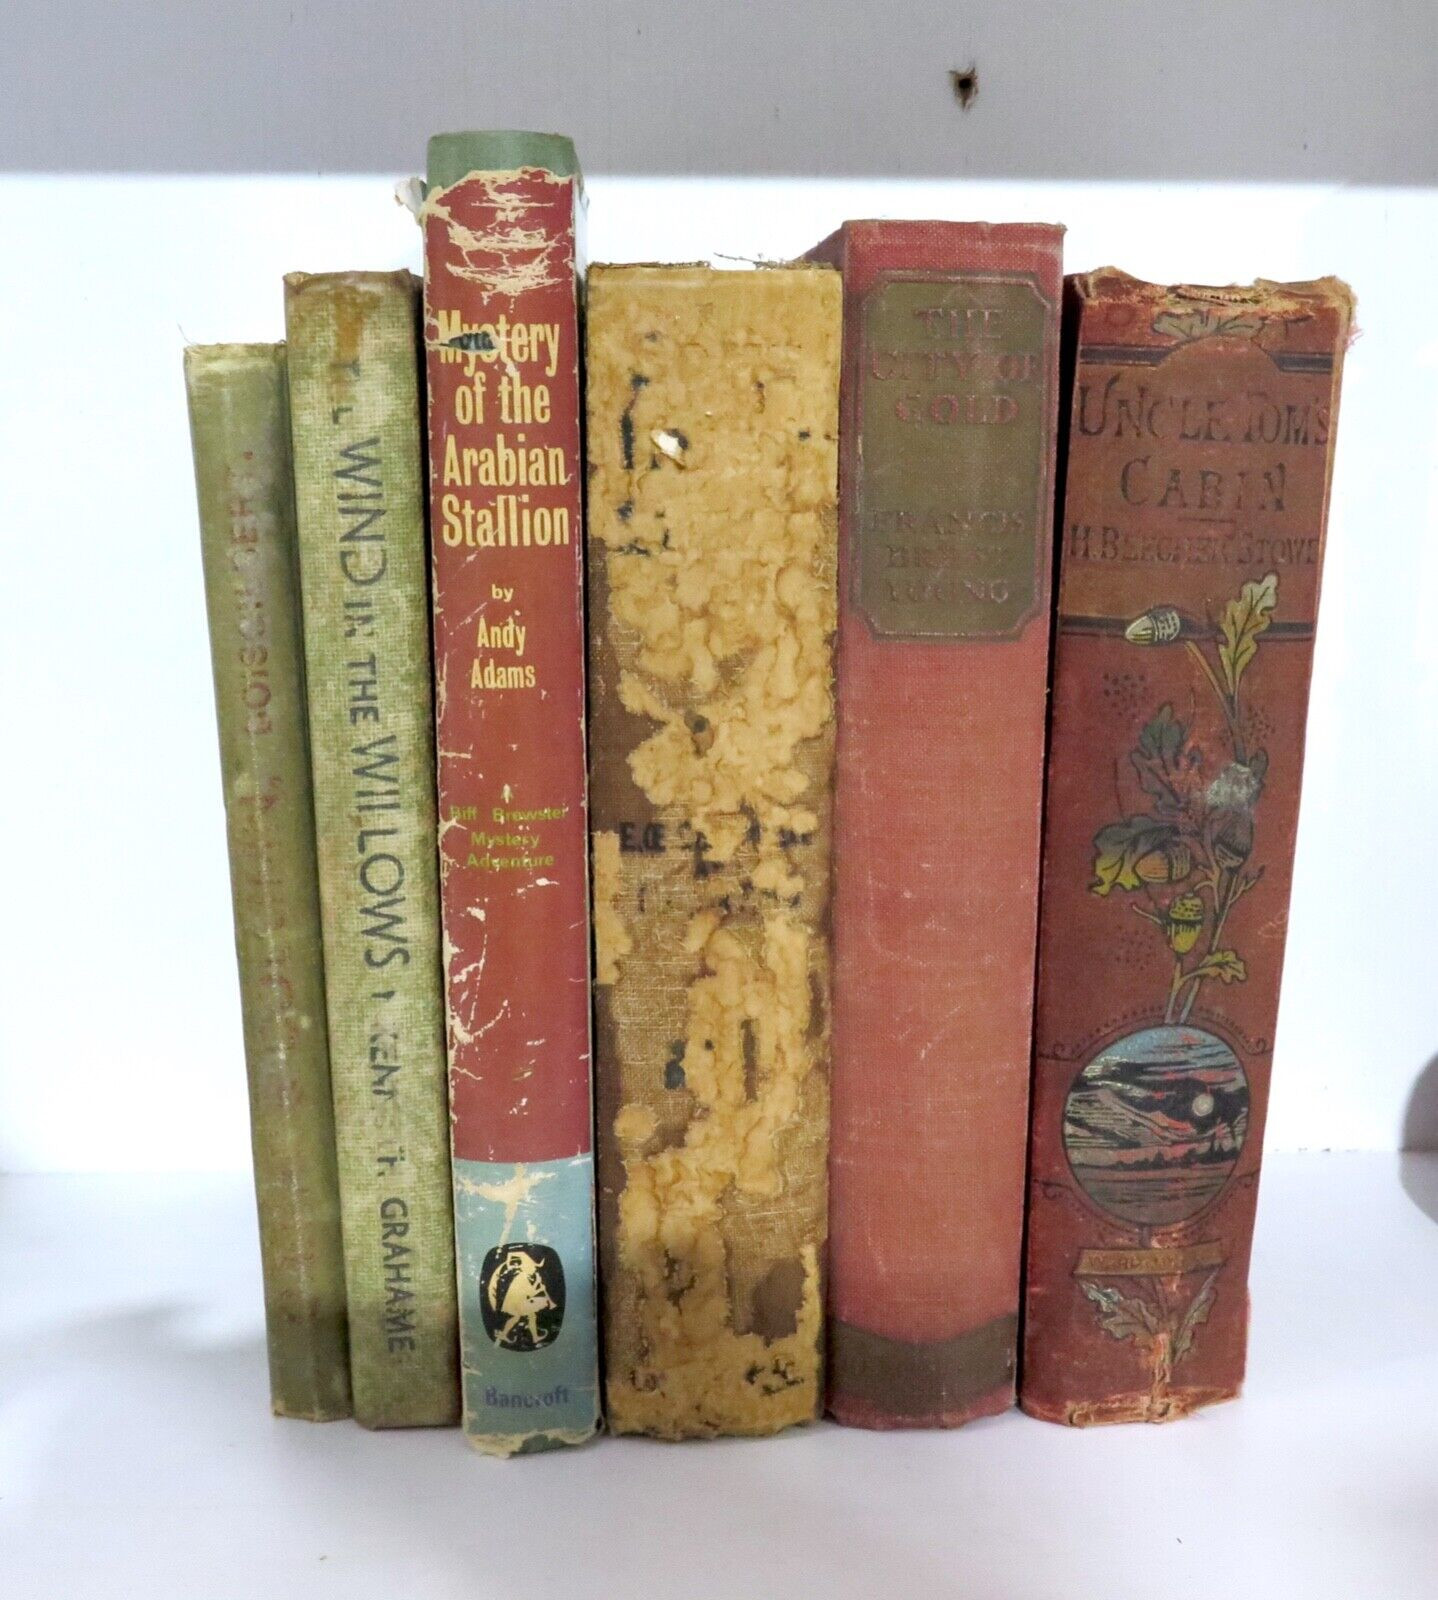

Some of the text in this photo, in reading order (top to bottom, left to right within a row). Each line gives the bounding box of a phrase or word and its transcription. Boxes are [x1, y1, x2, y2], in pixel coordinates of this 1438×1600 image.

[454, 371, 550, 425] of the
[1079, 373, 1232, 441] UNCLE
[443, 433, 570, 487] Arabian
[1119, 455, 1287, 511] CABIN
[332, 435, 389, 586] WIND
[441, 493, 570, 547] Stallion
[491, 583, 514, 602] by
[476, 614, 527, 656] Andy
[346, 653, 380, 726] THE
[470, 657, 536, 689] Adams
[466, 853, 555, 869] Adventure
[470, 832, 540, 849] Mystery
[380, 1197, 417, 1353] GRAHAME
[485, 1385, 569, 1408] Bancroft
